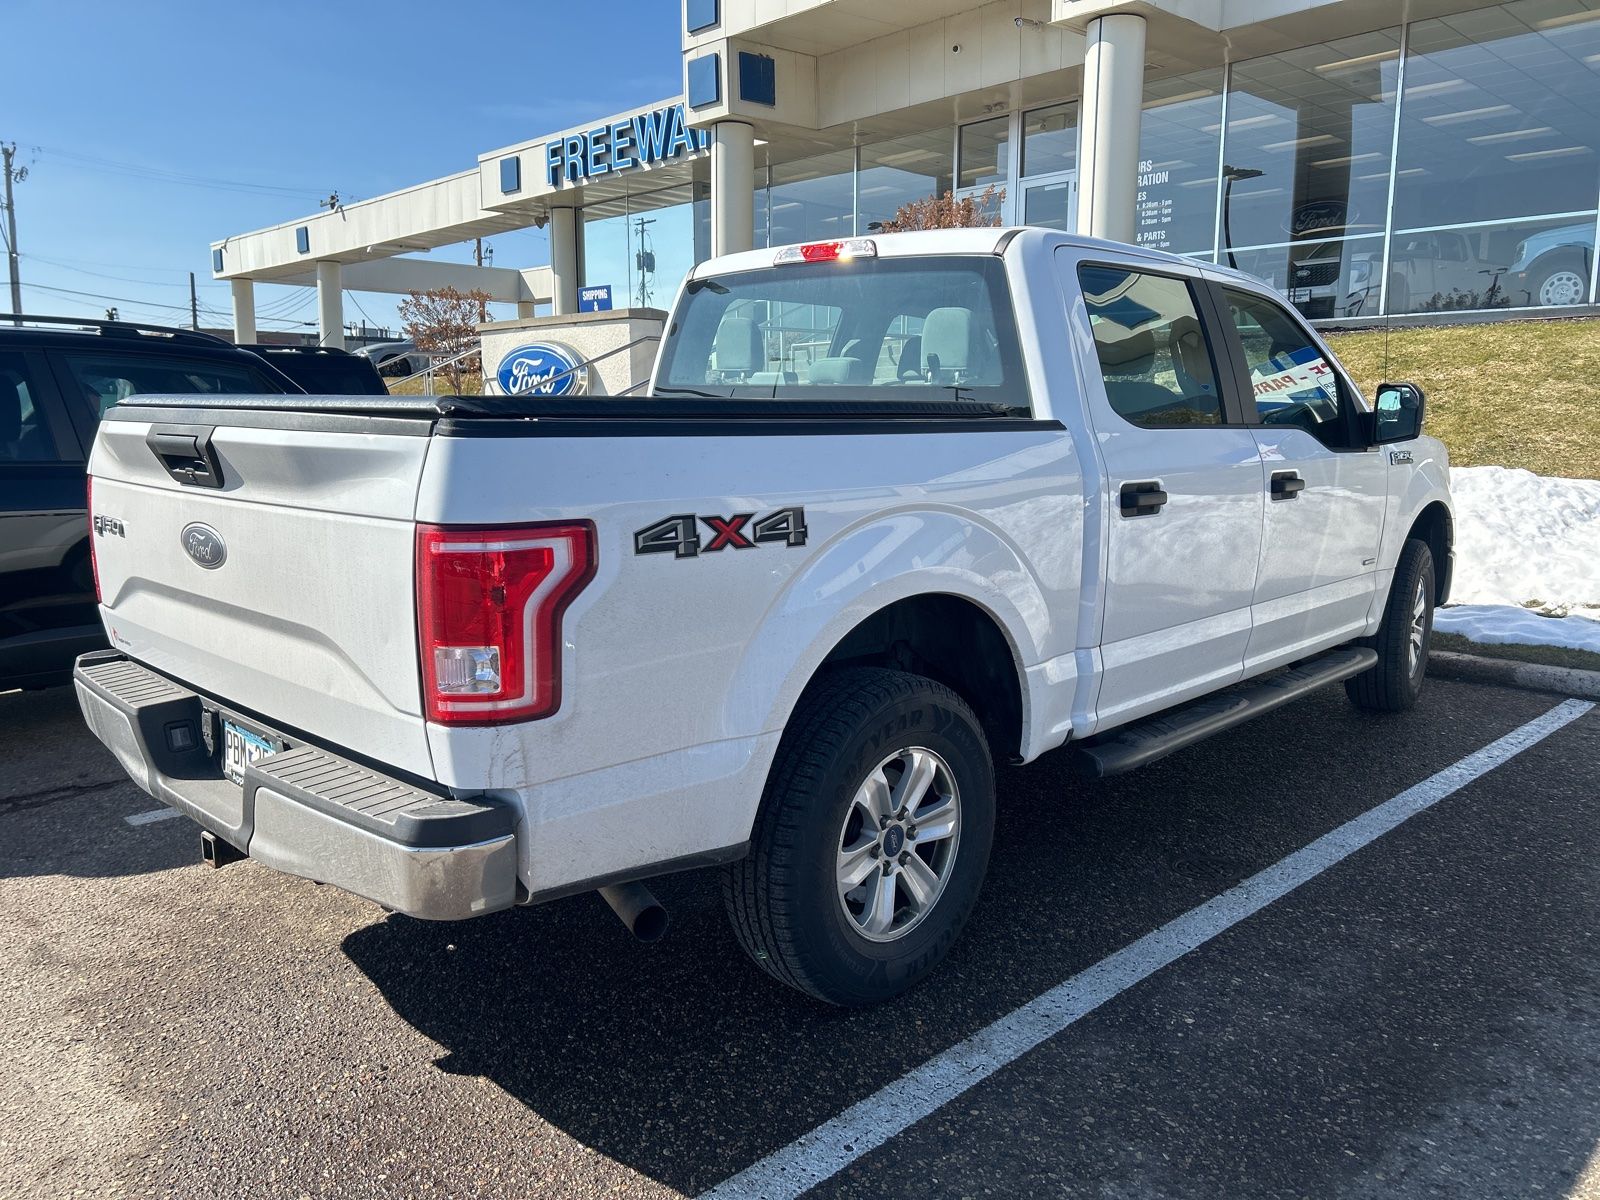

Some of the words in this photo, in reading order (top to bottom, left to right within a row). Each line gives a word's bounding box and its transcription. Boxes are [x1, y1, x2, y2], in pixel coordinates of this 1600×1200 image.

[1143, 230, 1166, 241] PARTS
[582, 289, 608, 301] SHIPPING
[593, 301, 599, 311] &
[509, 358, 556, 395] Ford
[189, 532, 212, 560] Ford
